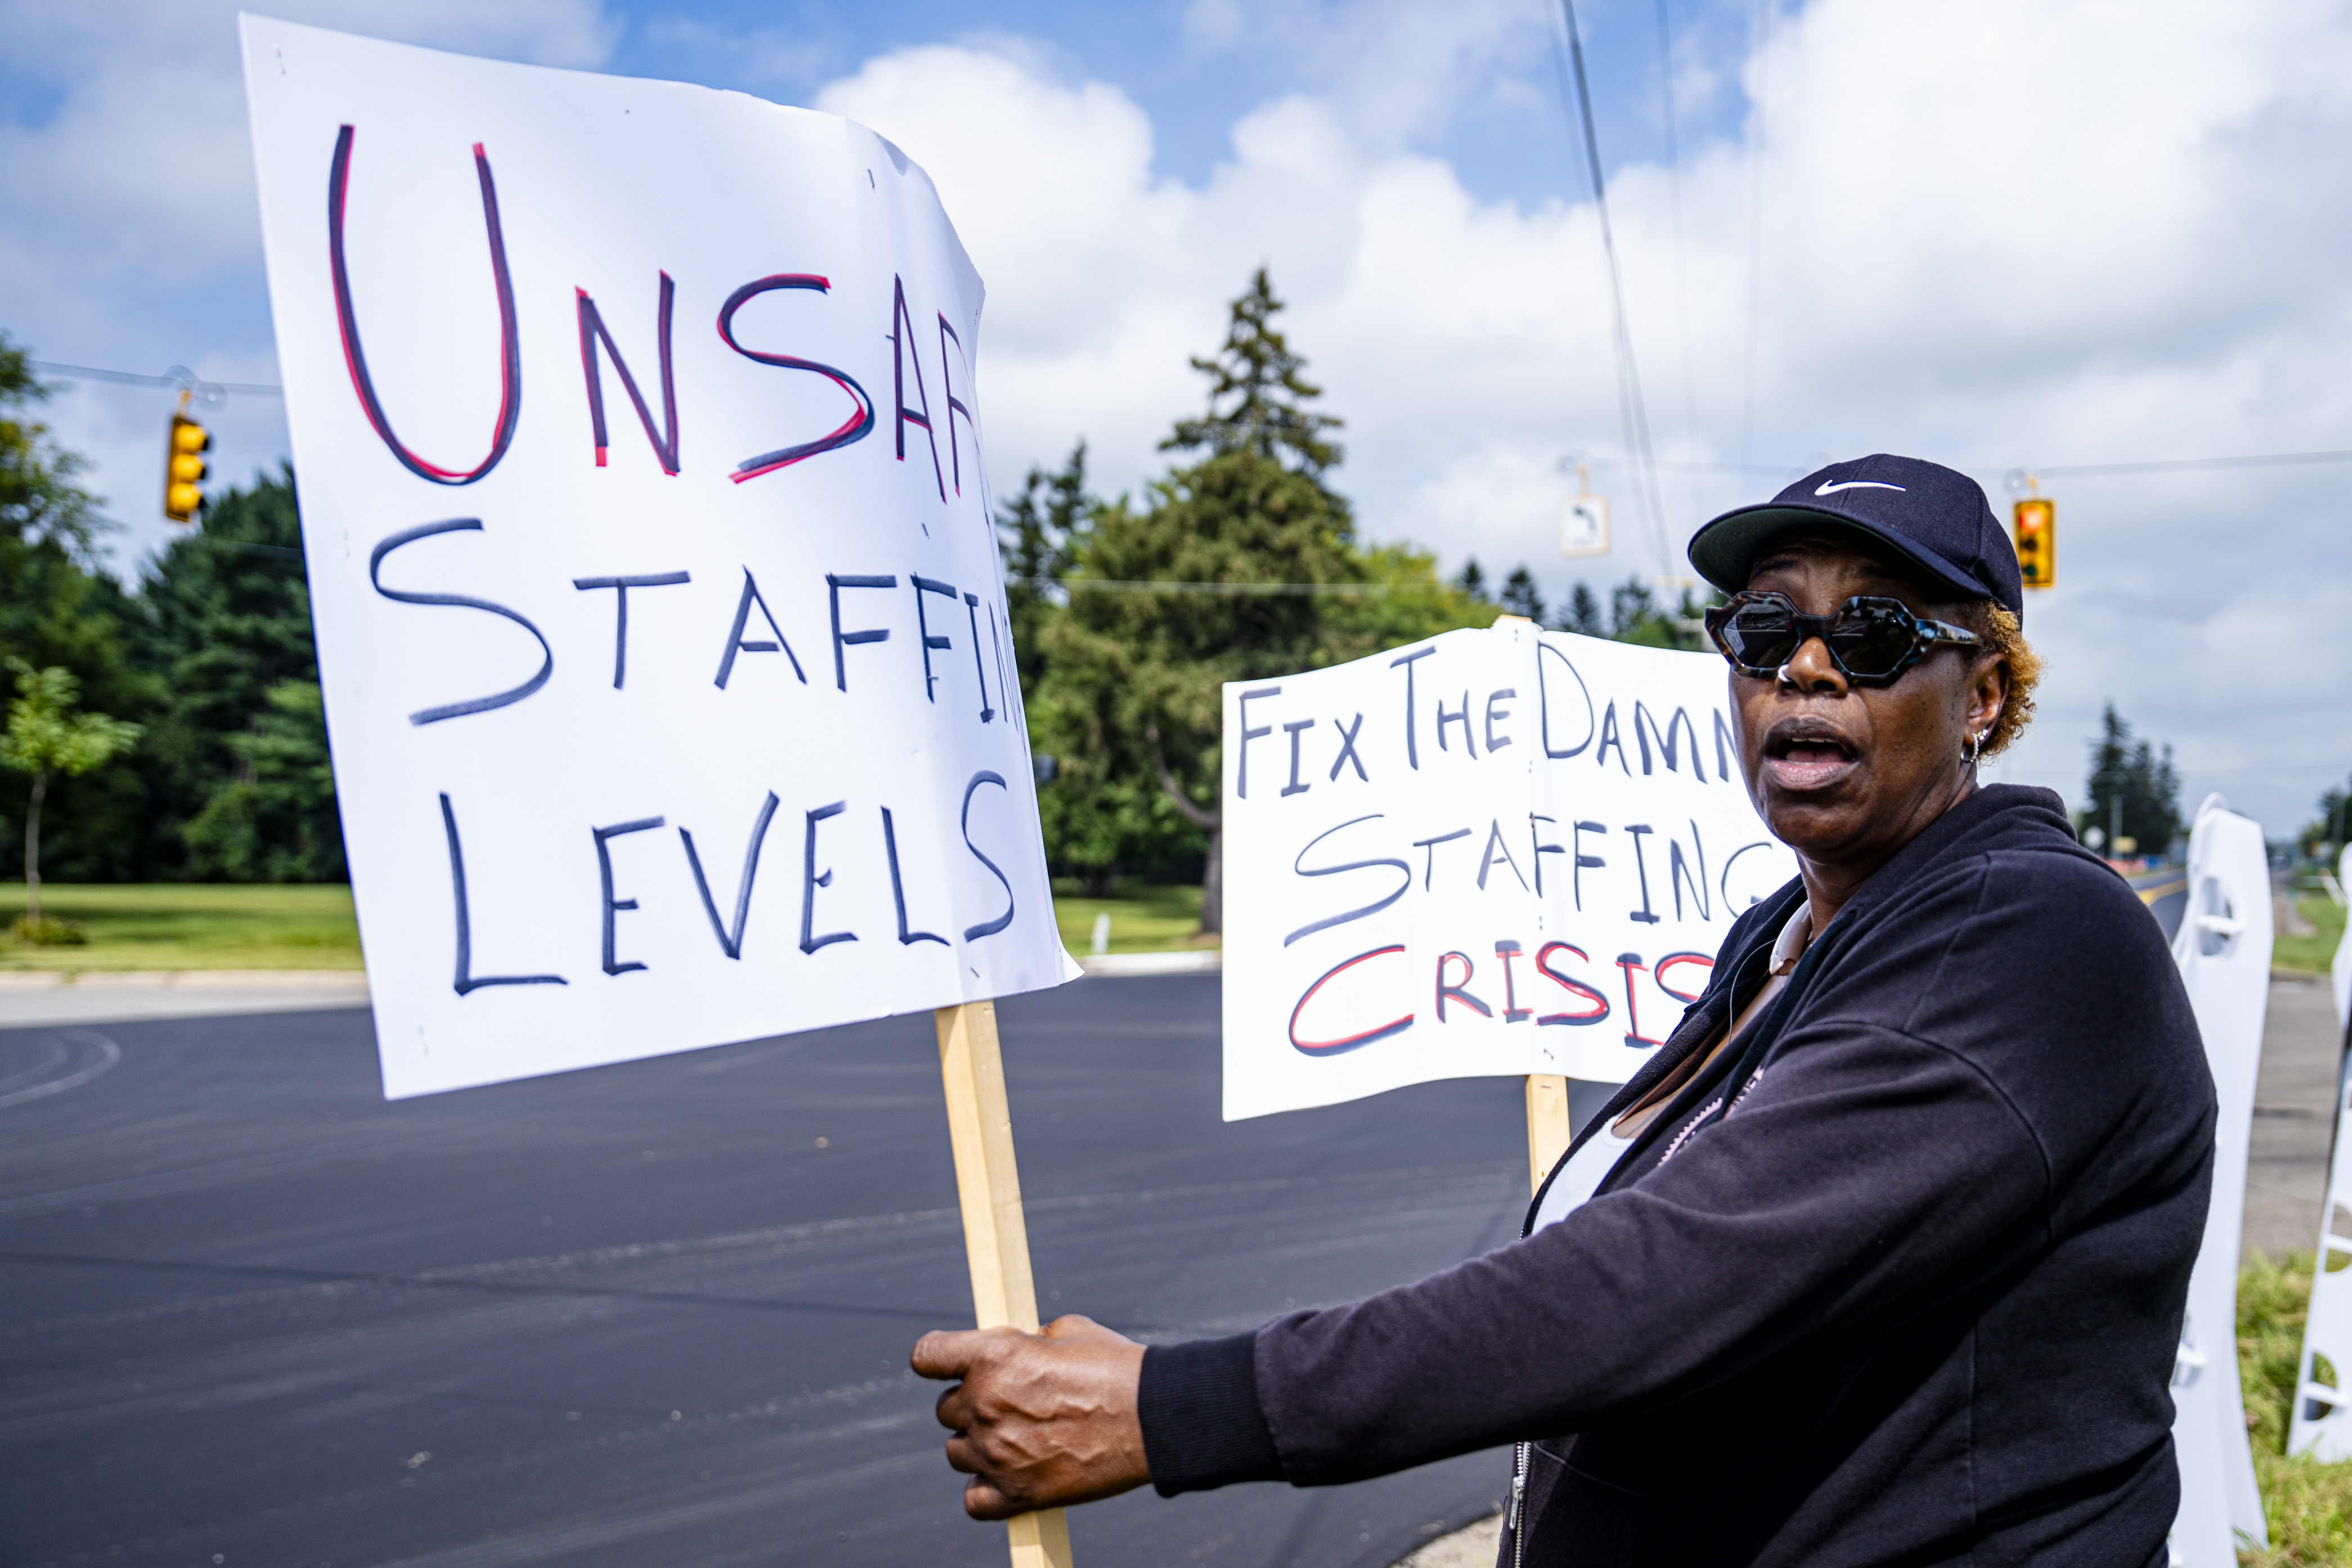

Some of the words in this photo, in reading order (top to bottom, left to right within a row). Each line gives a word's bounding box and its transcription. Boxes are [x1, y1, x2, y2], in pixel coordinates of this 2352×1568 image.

[329, 124, 982, 505] UNSAF
[369, 518, 1027, 755] STAFFIN
[1238, 686, 1369, 799] FIX
[1390, 645, 1518, 771] THE
[439, 770, 1015, 998] LEVELS
[1284, 812, 1772, 948] STAFFING
